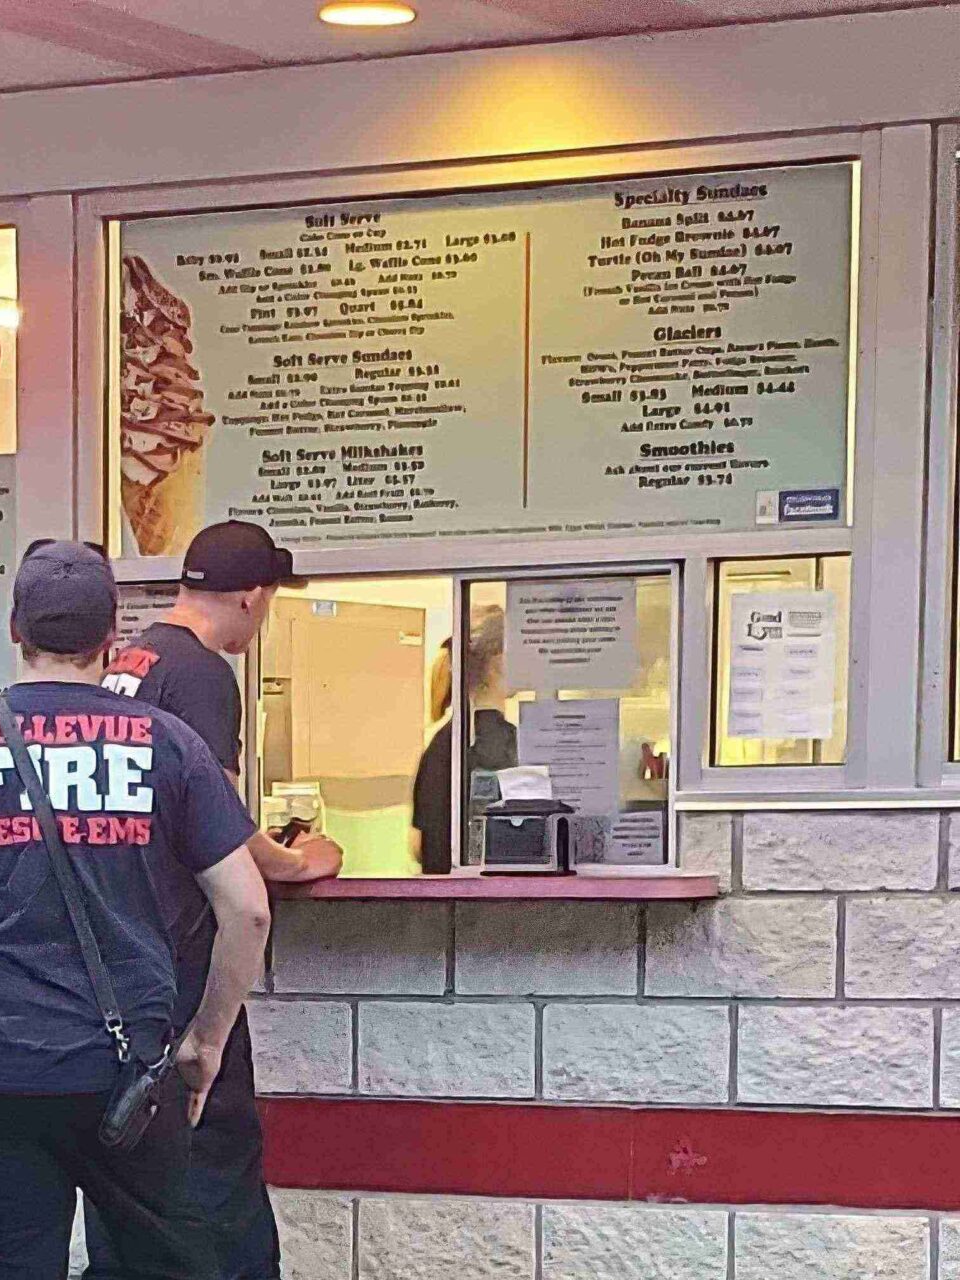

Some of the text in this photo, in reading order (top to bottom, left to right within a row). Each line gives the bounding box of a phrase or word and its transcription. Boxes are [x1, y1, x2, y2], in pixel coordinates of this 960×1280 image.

[614, 184, 768, 208] Specialty Sundaes
[622, 212, 709, 229] Banana Split
[260, 248, 293, 259] Small
[345, 243, 392, 253] Medium
[446, 235, 479, 247] Large
[601, 229, 735, 249] Hot Fudge Brownie
[588, 253, 631, 267] Turtle
[636, 251, 661, 265] (Oh
[666, 249, 684, 263] My
[224, 268, 261, 279] Waffle
[264, 266, 293, 276] Cone
[370, 258, 408, 268] Waffle
[412, 256, 441, 265] Cone
[632, 266, 702, 281] Pecan Ball
[340, 302, 375, 315] Quart
[654, 326, 722, 342] Glaciers
[273, 348, 412, 367] Soft Serve Sundaes
[248, 368, 401, 385] Small Regular
[582, 384, 749, 404] Small Medium
[643, 404, 682, 418] Large
[621, 421, 644, 433] Add
[262, 444, 423, 463] Soft Serve Milkshakes
[640, 441, 735, 458] Smoothies
[271, 479, 301, 490] Large
[639, 475, 690, 489] Regular
